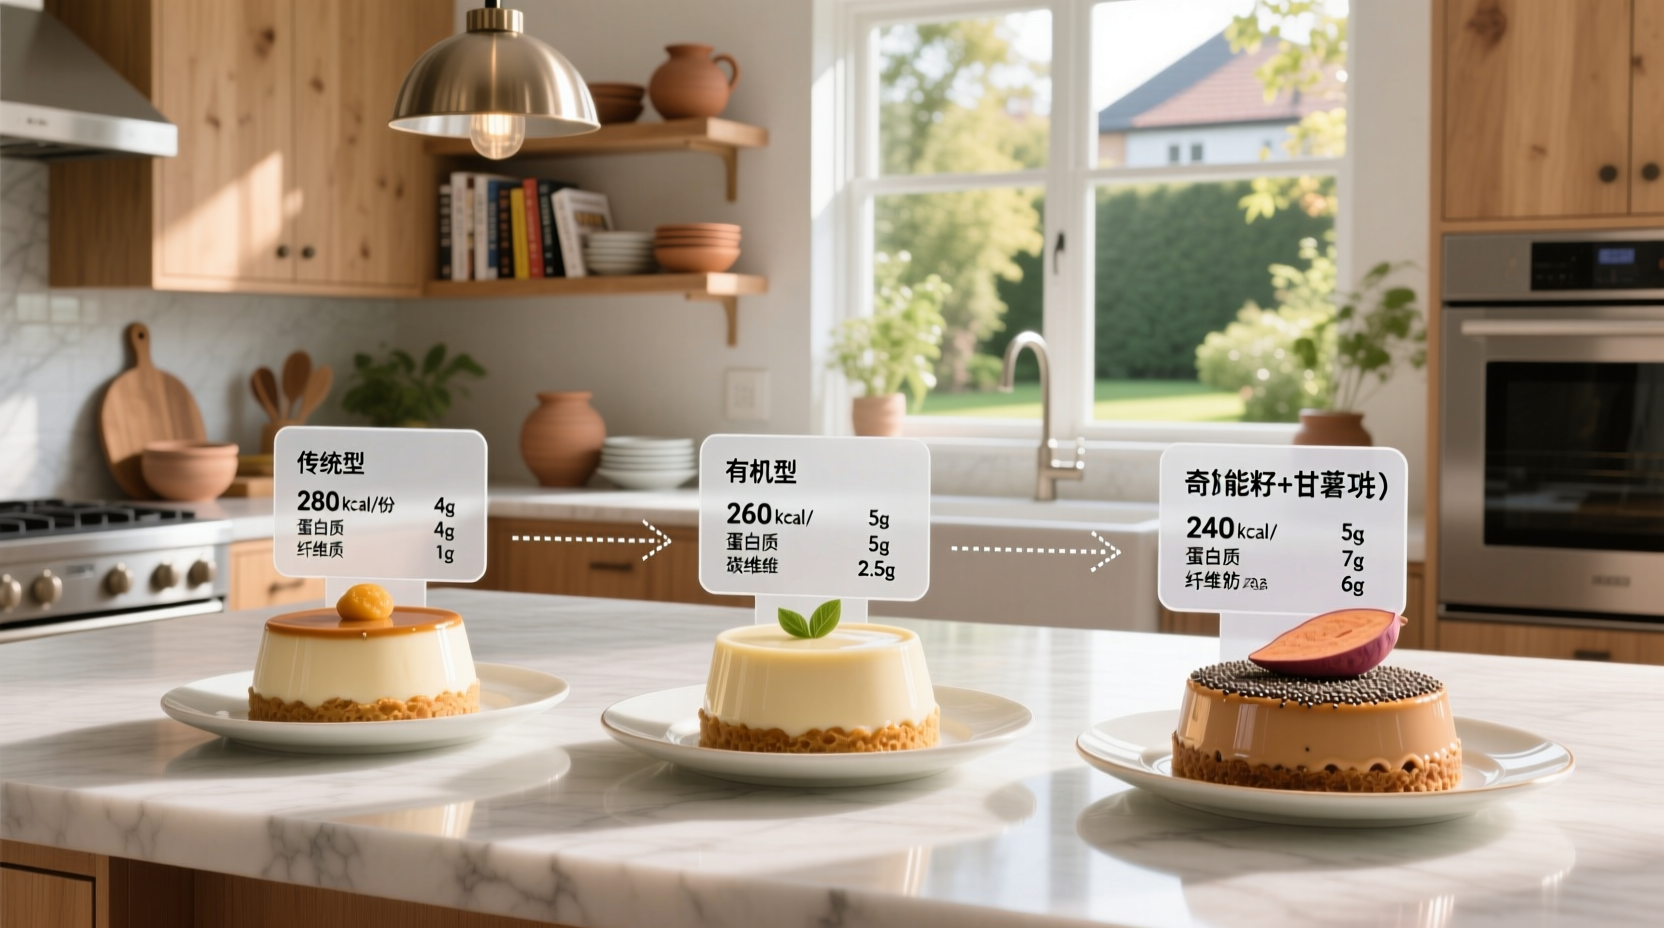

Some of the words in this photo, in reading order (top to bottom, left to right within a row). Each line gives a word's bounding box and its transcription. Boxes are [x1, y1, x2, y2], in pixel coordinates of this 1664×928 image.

[296, 450, 365, 475] 传统型
[725, 457, 797, 484] 有机型
[297, 489, 340, 512] 280
[433, 496, 456, 518] 4g
[726, 502, 772, 525] 260
[868, 509, 890, 530] 5g
[296, 518, 344, 537] 蛋白质
[433, 520, 455, 542] 4g
[1186, 515, 1235, 540] 240
[1341, 522, 1365, 546] 5g
[296, 540, 344, 559] 纤维质
[436, 544, 455, 564] 1g
[725, 531, 779, 552] 蛋白质
[868, 534, 890, 557] 5g
[857, 559, 896, 582] 2.5g
[1185, 546, 1240, 566] 蛋白质
[1341, 549, 1365, 572] 7g
[1341, 575, 1365, 597] 6g
